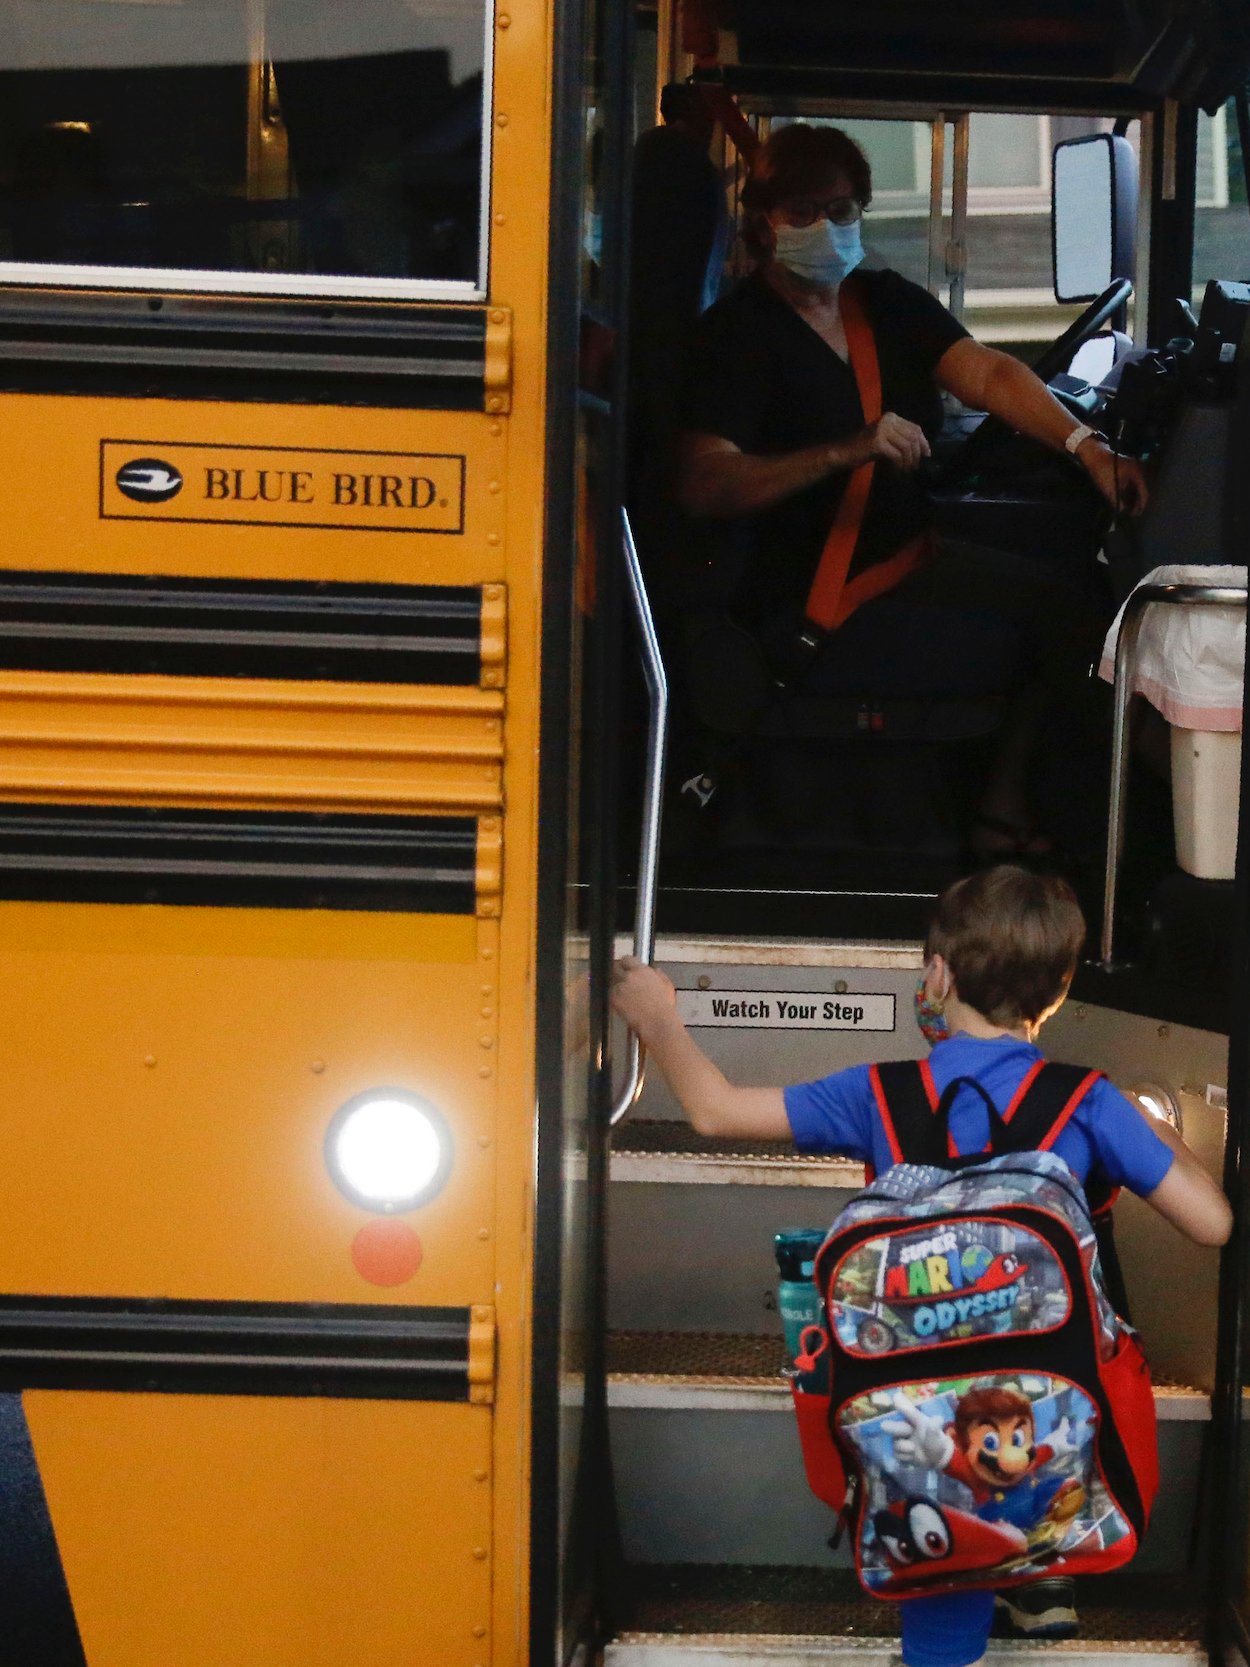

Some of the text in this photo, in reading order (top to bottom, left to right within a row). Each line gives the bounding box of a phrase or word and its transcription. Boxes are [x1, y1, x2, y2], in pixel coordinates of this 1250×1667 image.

[203, 467, 314, 503] BLUE
[711, 999, 864, 1024] Watch Your Step
